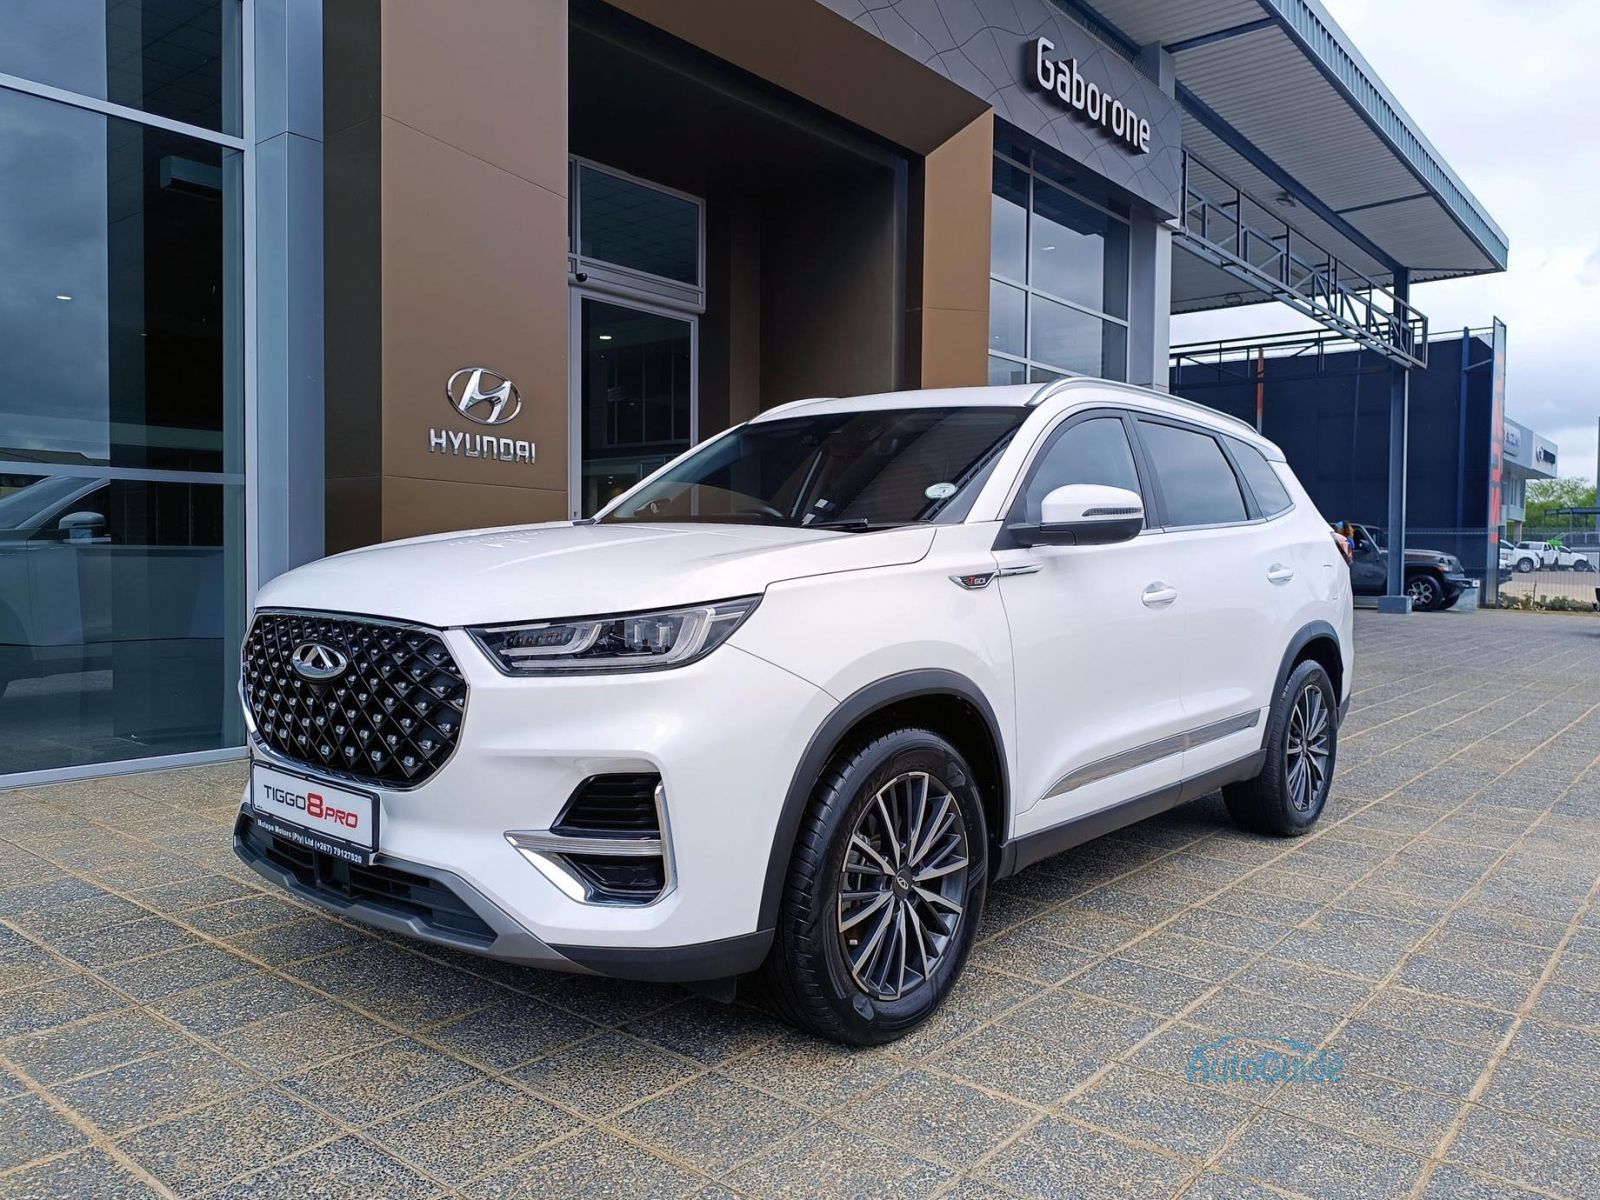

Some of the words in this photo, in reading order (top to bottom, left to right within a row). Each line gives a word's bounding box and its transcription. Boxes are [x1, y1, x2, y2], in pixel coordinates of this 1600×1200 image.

[1037, 36, 1151, 154] Gaborone
[429, 428, 536, 464] HYUNDAI
[275, 825, 292, 838] Motors
[305, 837, 313, 846] Ltd
